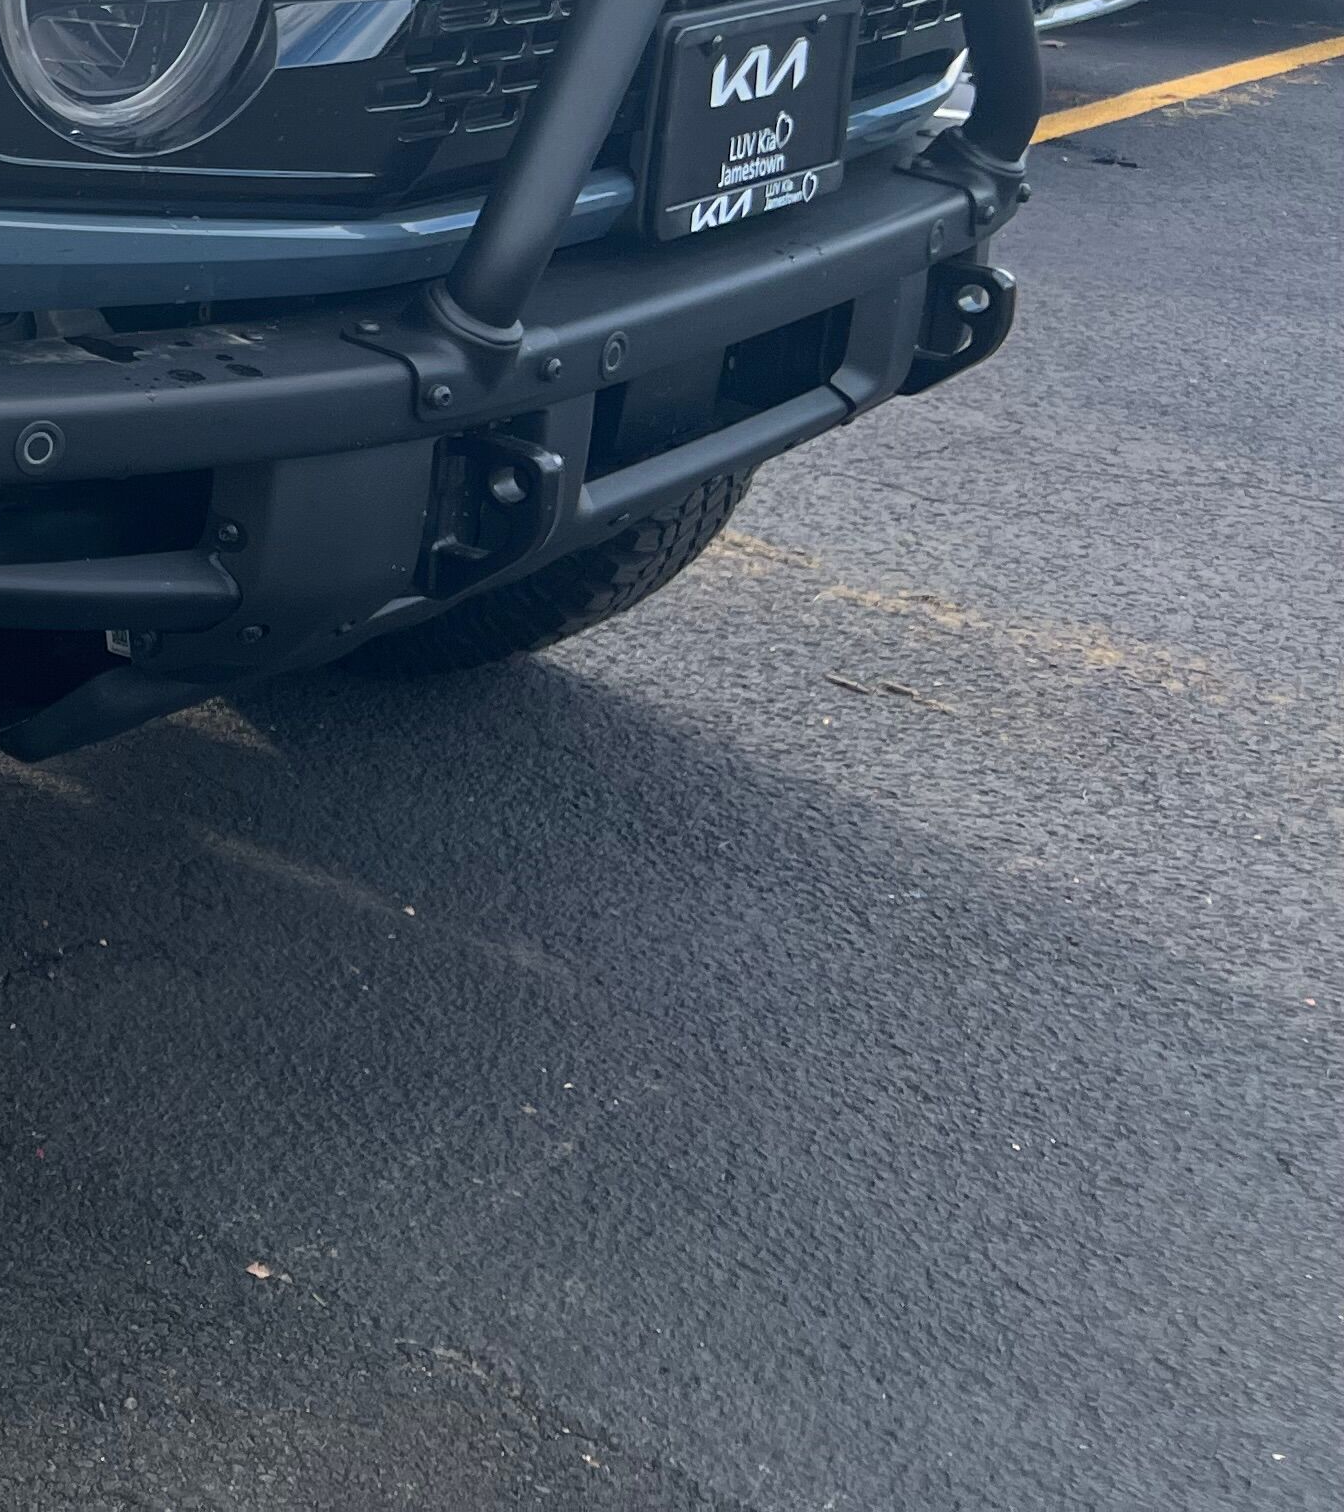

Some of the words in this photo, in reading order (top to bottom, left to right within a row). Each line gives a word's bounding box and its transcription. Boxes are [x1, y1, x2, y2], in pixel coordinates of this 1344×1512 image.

[710, 36, 808, 108] KIA
[730, 132, 757, 162] LUV
[757, 127, 777, 155] Kia
[718, 153, 786, 188] Jamestown
